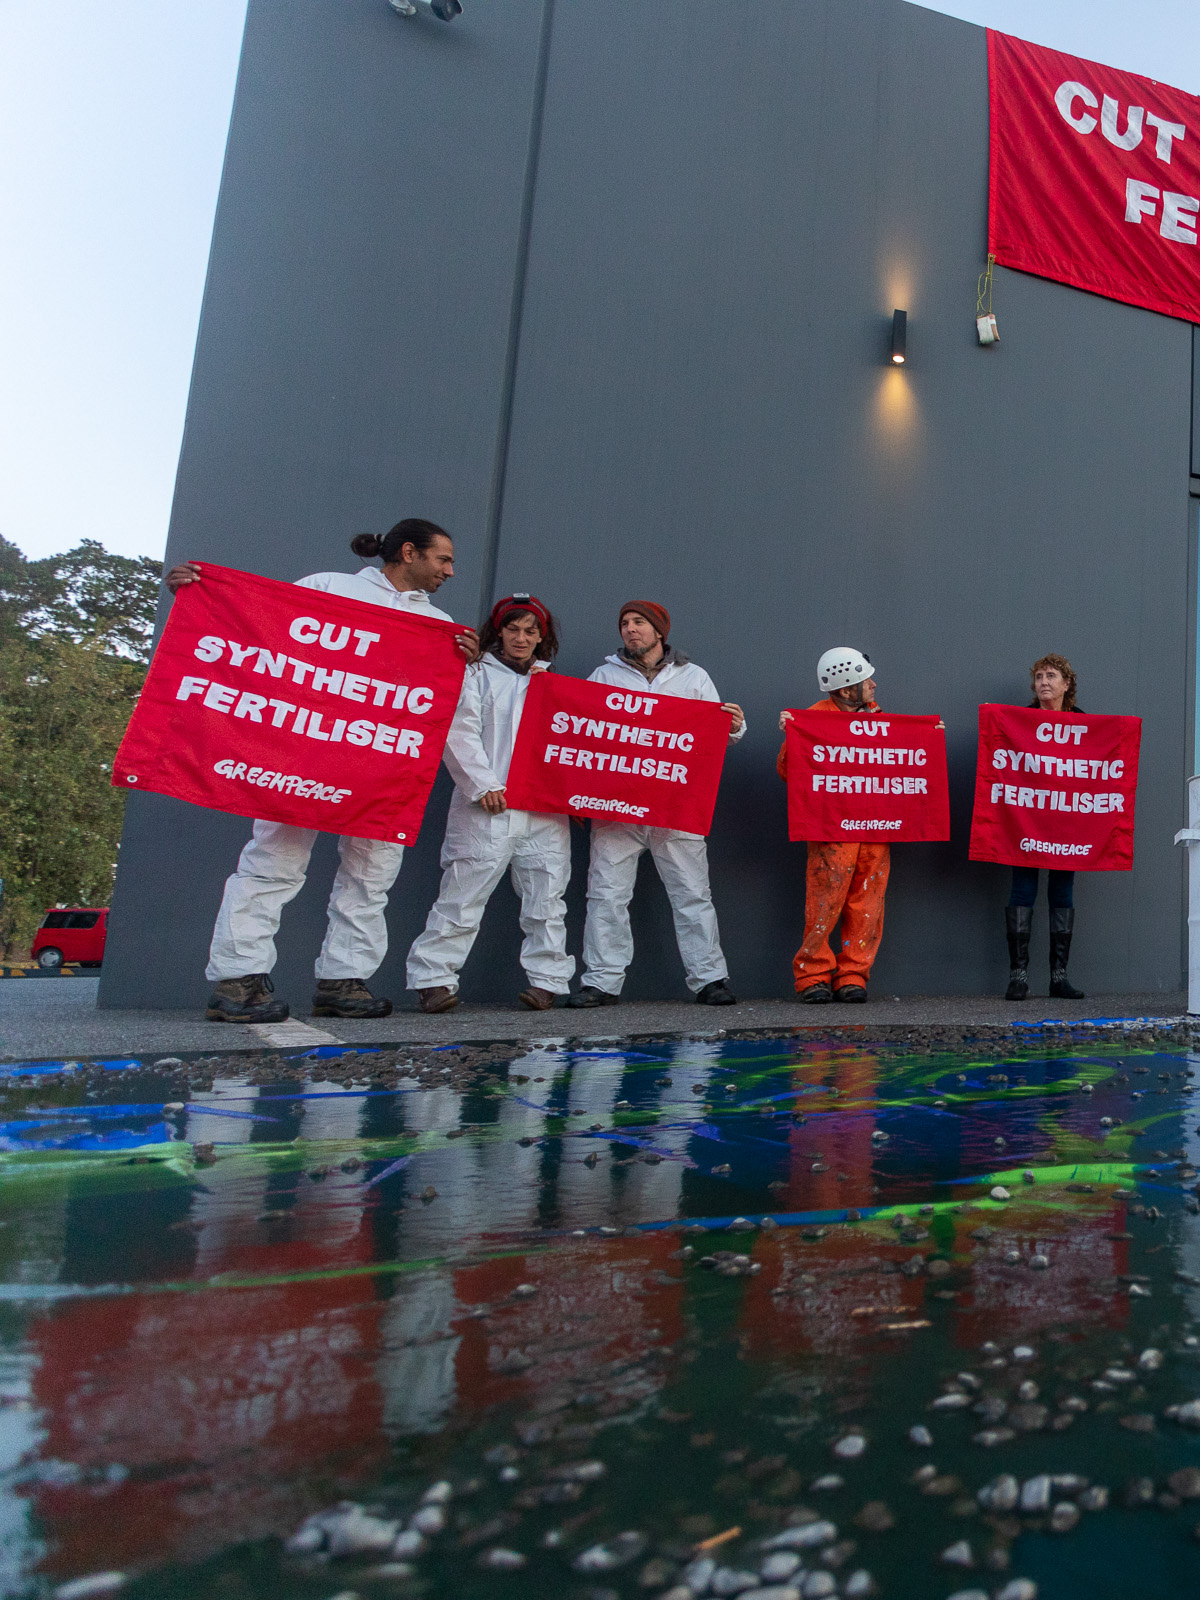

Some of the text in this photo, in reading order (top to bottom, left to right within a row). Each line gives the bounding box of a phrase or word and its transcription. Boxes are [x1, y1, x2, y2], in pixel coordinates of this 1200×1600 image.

[1054, 80, 1185, 165] CUT
[288, 616, 381, 657] CUT
[193, 635, 434, 715] SYNTHETIC
[175, 675, 425, 759] FERTILISER
[605, 692, 659, 716] CUT
[550, 711, 695, 753] SYNTHETIC
[849, 720, 891, 737] CUT
[1035, 722, 1089, 746] CUT
[543, 743, 688, 785] FERTILISER
[812, 744, 927, 766] SYNTHETIC
[992, 748, 1125, 781] SYNTHETIC
[213, 758, 353, 804] GREENPEACE
[812, 774, 928, 795] FERTILISER
[568, 794, 650, 818] GREENPEACE
[990, 782, 1125, 814] FERTILISER
[840, 818, 903, 831] GREENPEACE
[1019, 837, 1093, 856] GREENPEACE
